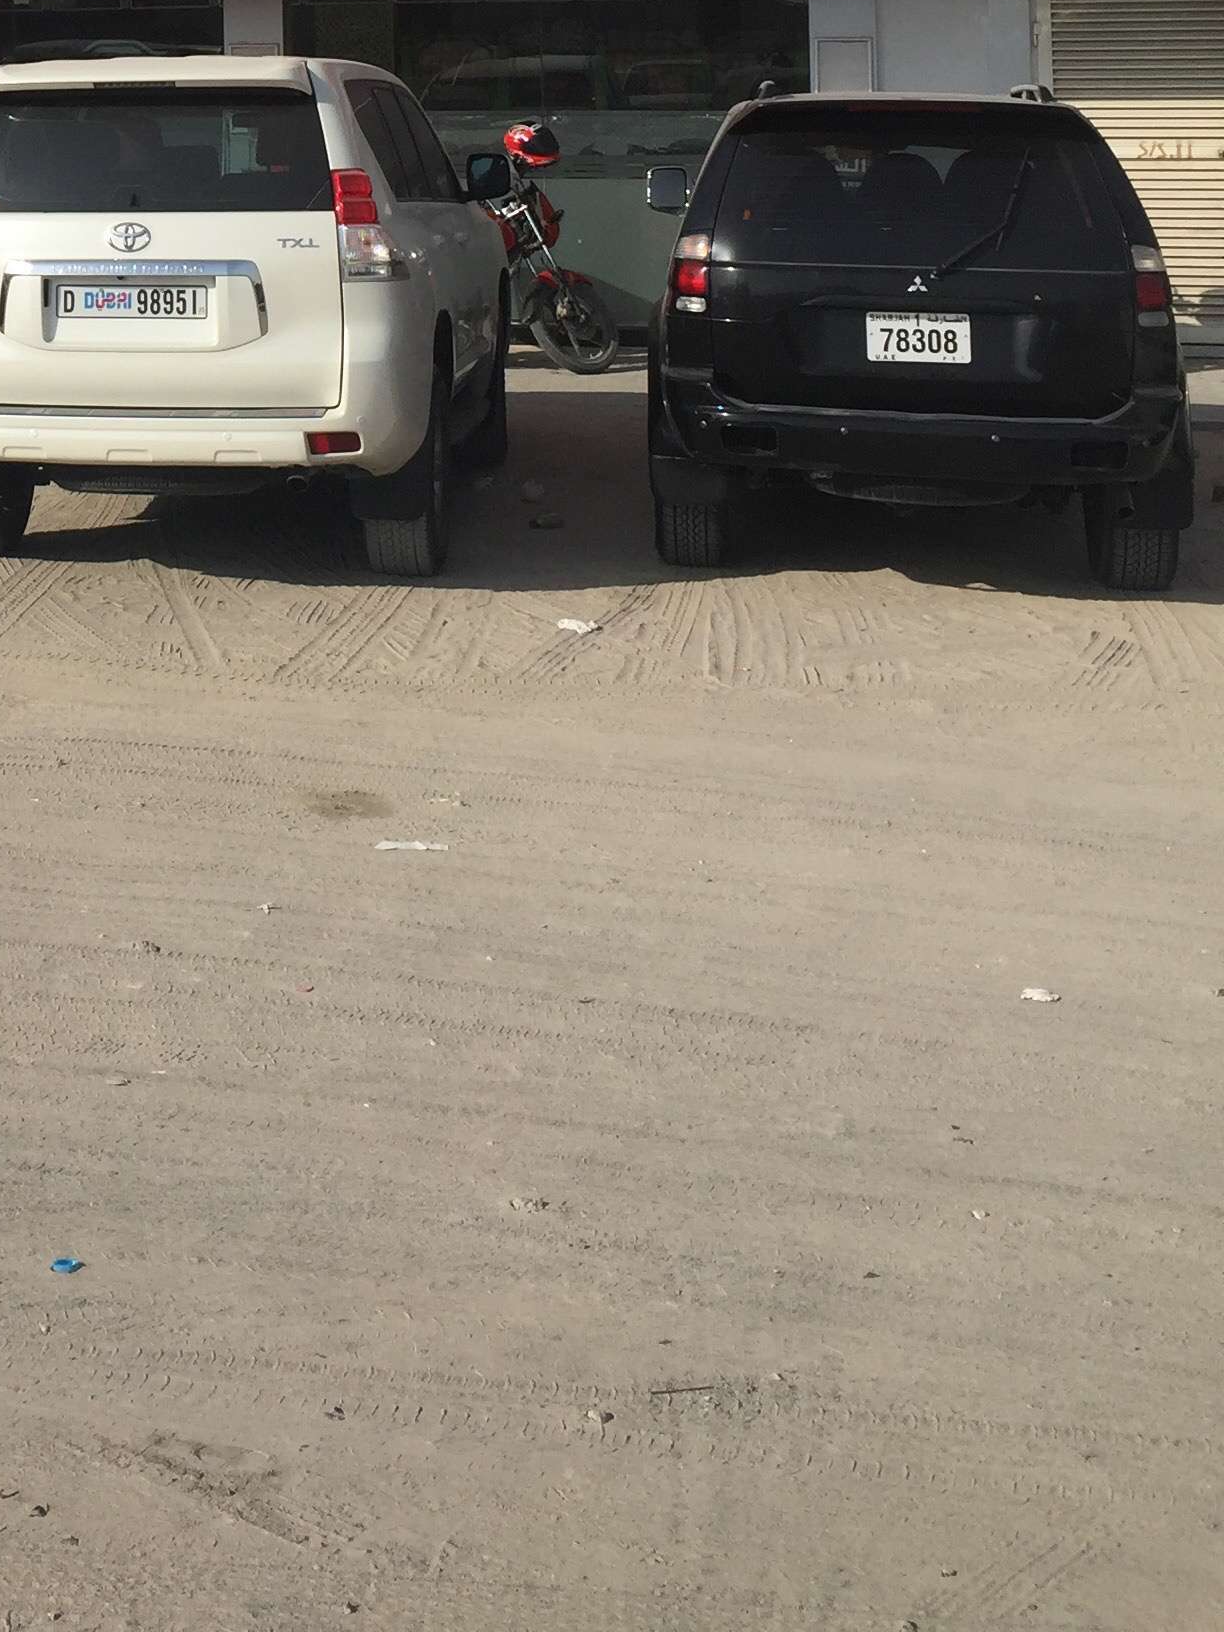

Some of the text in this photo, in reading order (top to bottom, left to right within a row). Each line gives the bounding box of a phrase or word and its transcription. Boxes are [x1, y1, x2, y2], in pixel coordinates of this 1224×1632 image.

[63, 290, 75, 313] D
[137, 289, 197, 315] 98951
[879, 328, 958, 354] 78308
